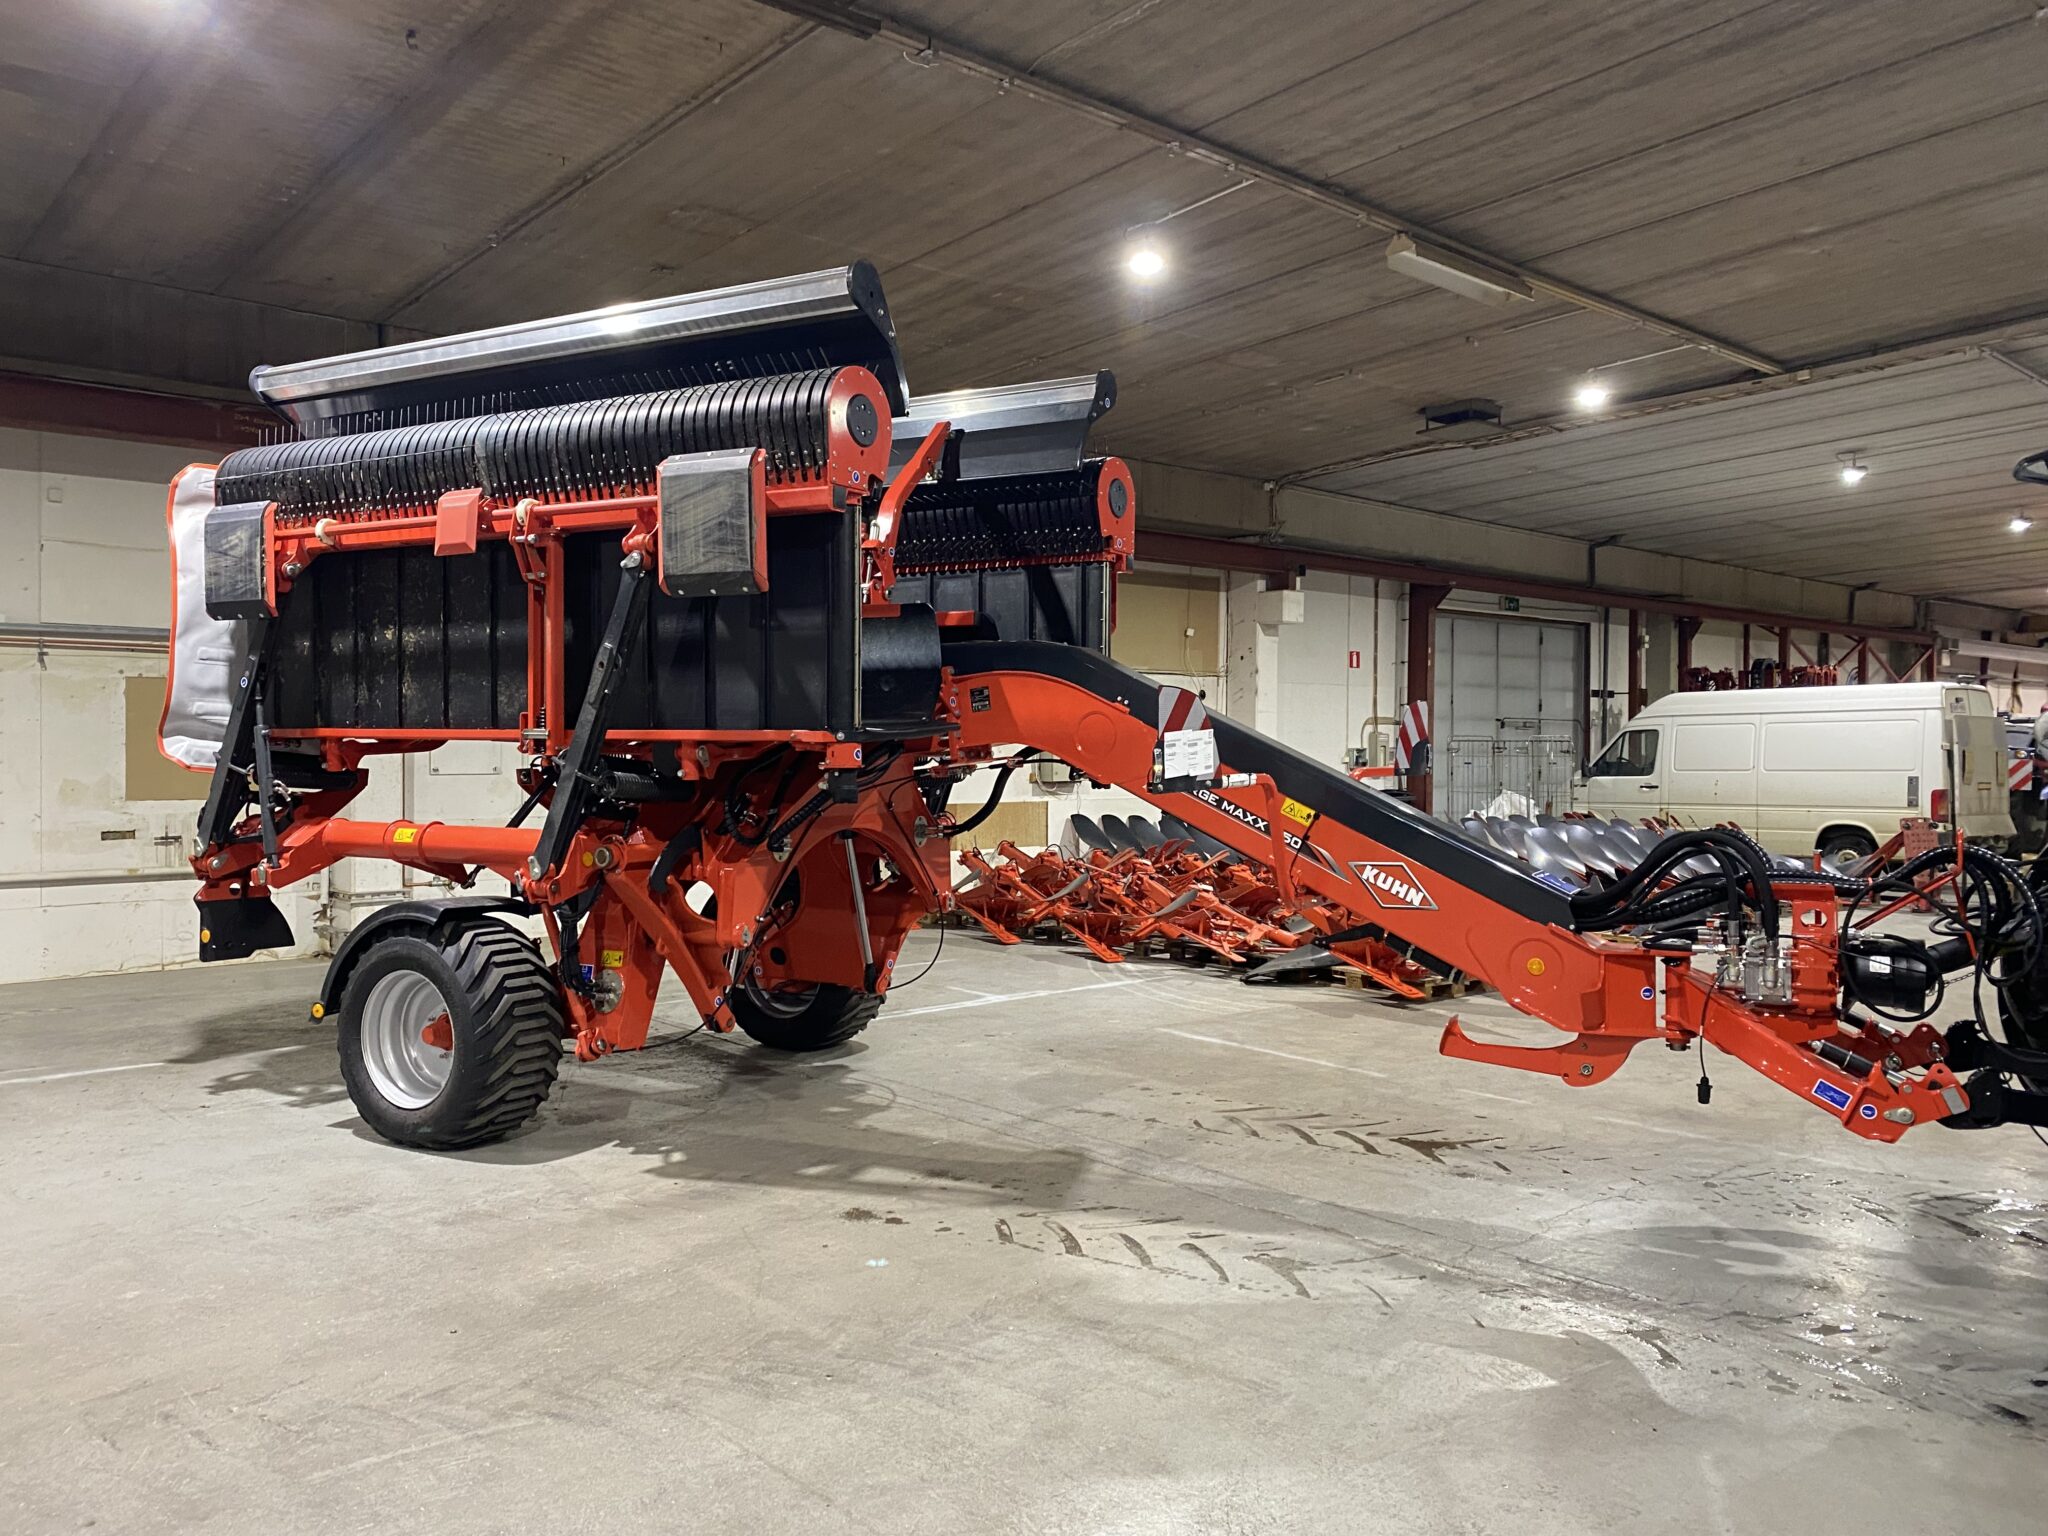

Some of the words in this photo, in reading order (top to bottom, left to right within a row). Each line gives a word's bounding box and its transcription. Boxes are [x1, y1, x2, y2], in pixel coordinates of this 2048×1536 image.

[1221, 800, 1269, 832] MAXX
[1283, 831, 1302, 849] 50
[1361, 864, 1424, 907] KUHN
